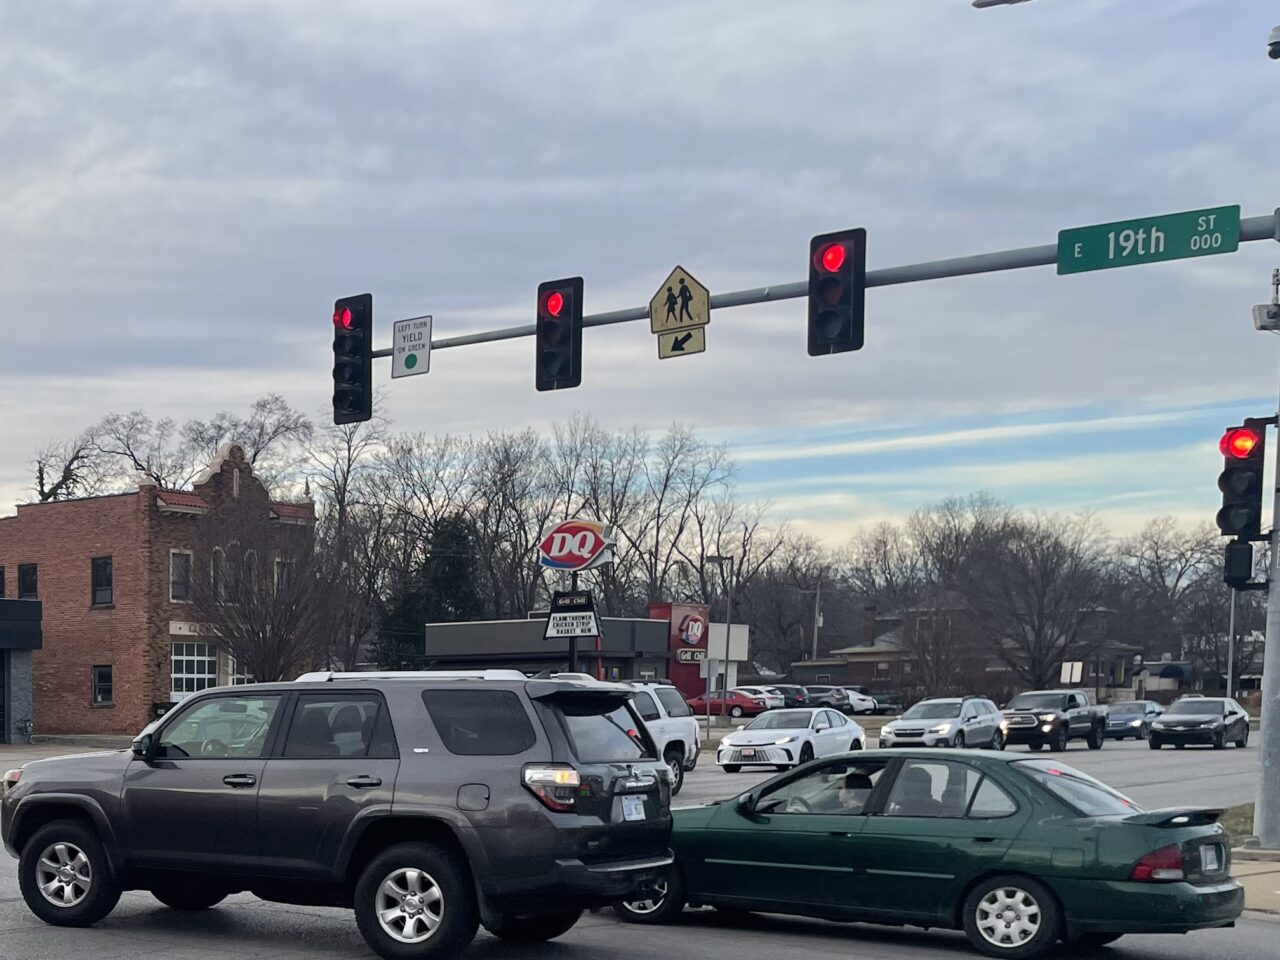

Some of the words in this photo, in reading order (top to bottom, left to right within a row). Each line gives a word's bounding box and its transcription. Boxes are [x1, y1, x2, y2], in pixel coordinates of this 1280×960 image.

[1198, 215, 1216, 231] ST
[1074, 243, 1083, 258] E
[1107, 226, 1165, 260] 19th
[1190, 232, 1222, 250] 000
[402, 332, 422, 343] YIELD
[549, 530, 595, 559] DQ
[687, 621, 702, 637] DQ
